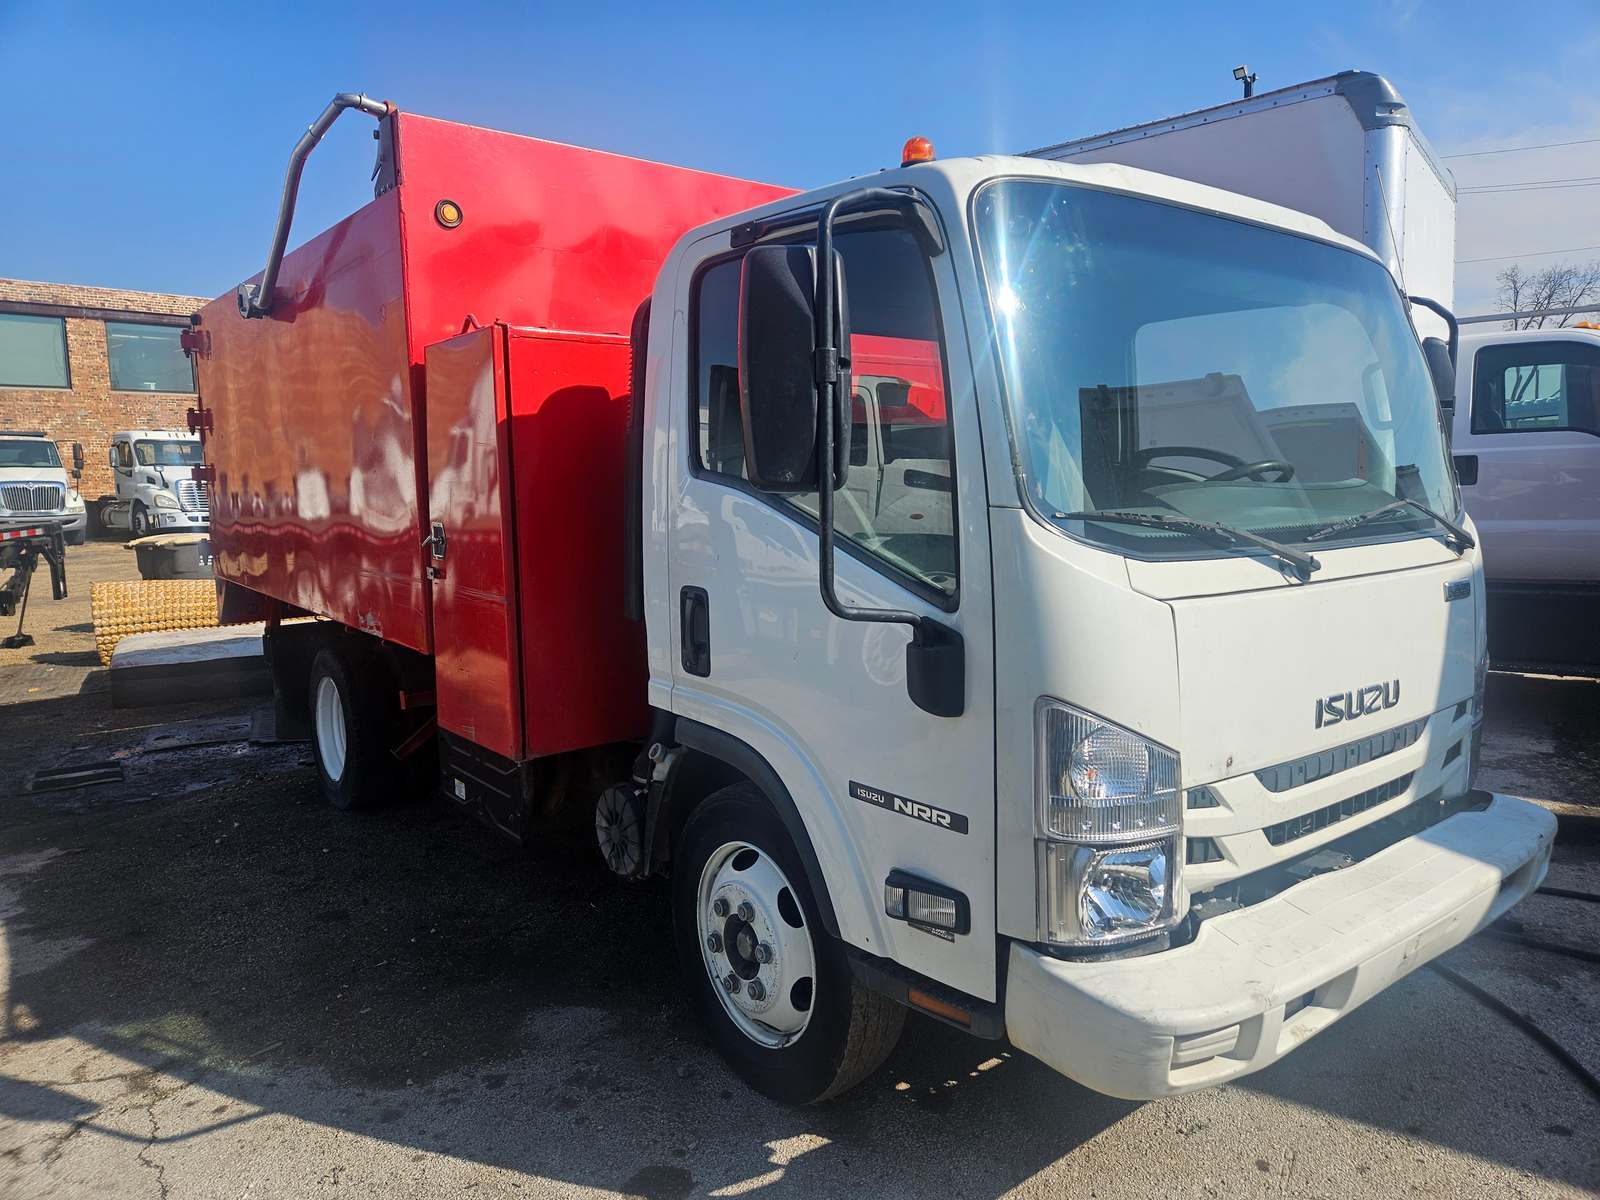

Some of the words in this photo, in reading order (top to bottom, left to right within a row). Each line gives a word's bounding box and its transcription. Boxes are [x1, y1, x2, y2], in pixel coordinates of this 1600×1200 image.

[1314, 679, 1400, 729] ISUZU
[857, 787, 885, 804] ISUZU
[894, 797, 951, 828] NRR
